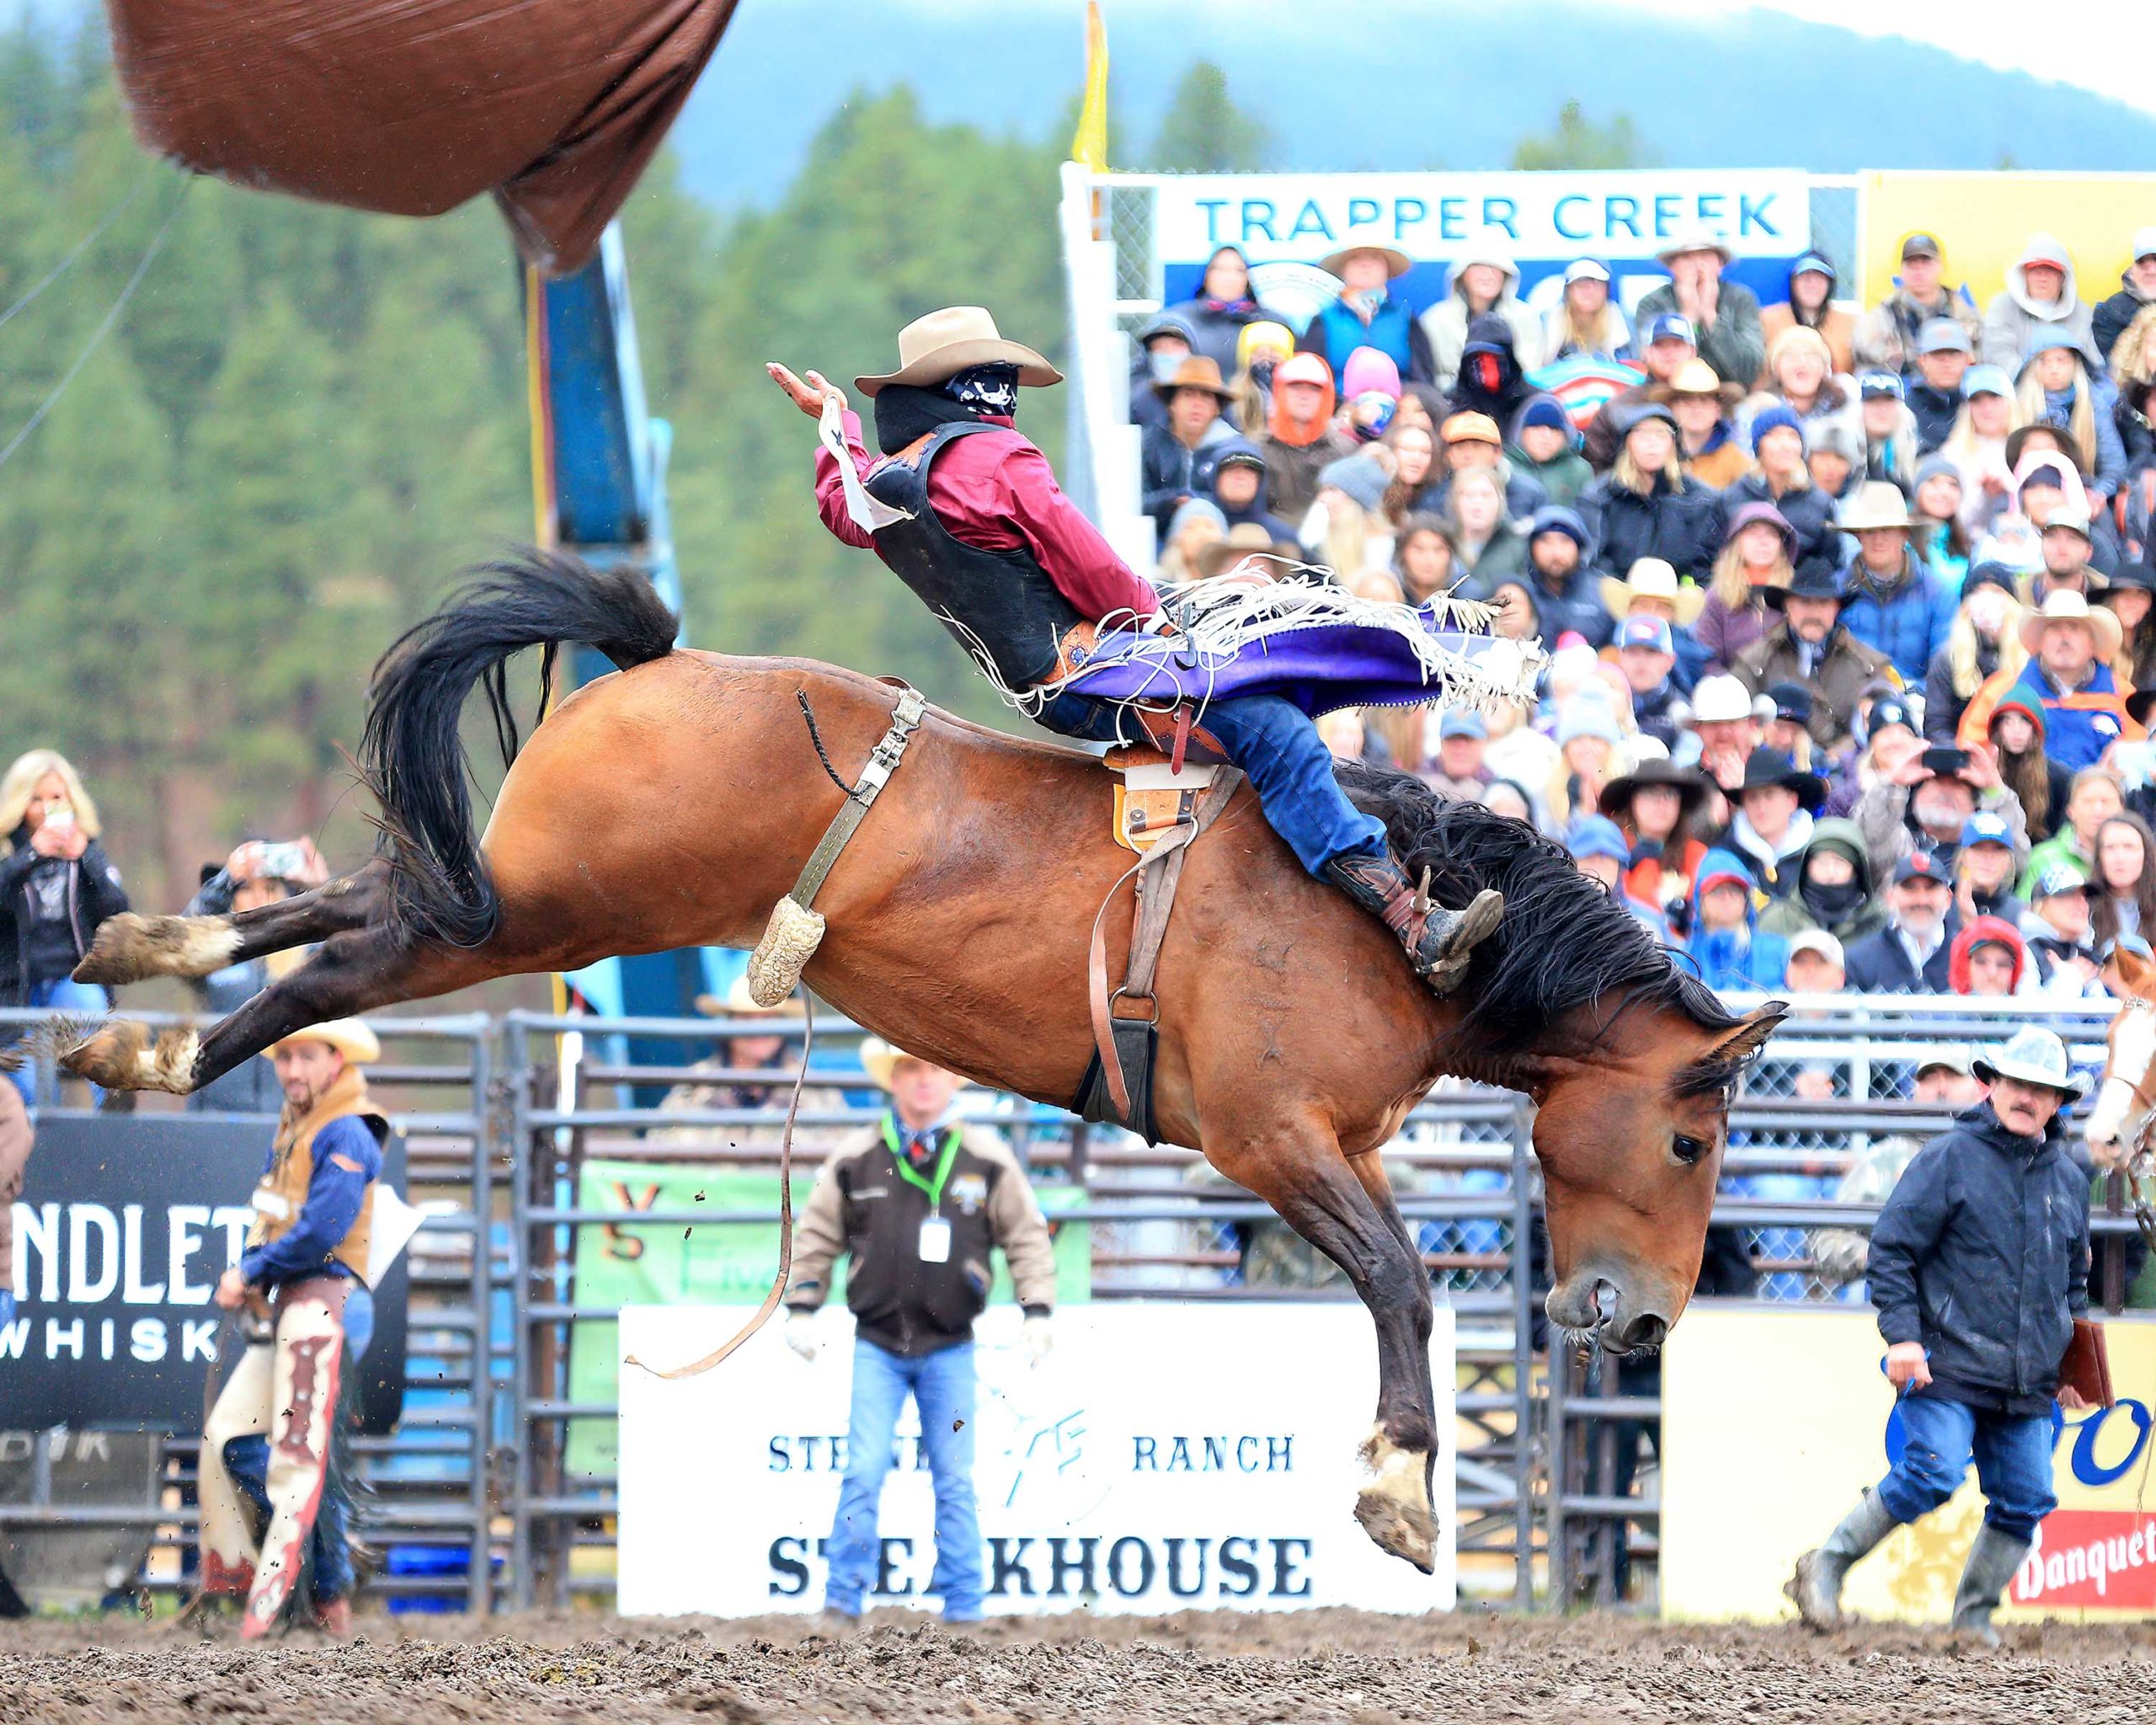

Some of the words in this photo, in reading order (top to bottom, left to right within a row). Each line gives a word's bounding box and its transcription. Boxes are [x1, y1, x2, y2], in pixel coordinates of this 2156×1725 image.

[1195, 197, 1519, 241] TRAPPER
[1553, 195, 1783, 239] CREEK
[1132, 1435, 1295, 1472] RANCH
[769, 1536, 1313, 1595] SEKHOUSE
